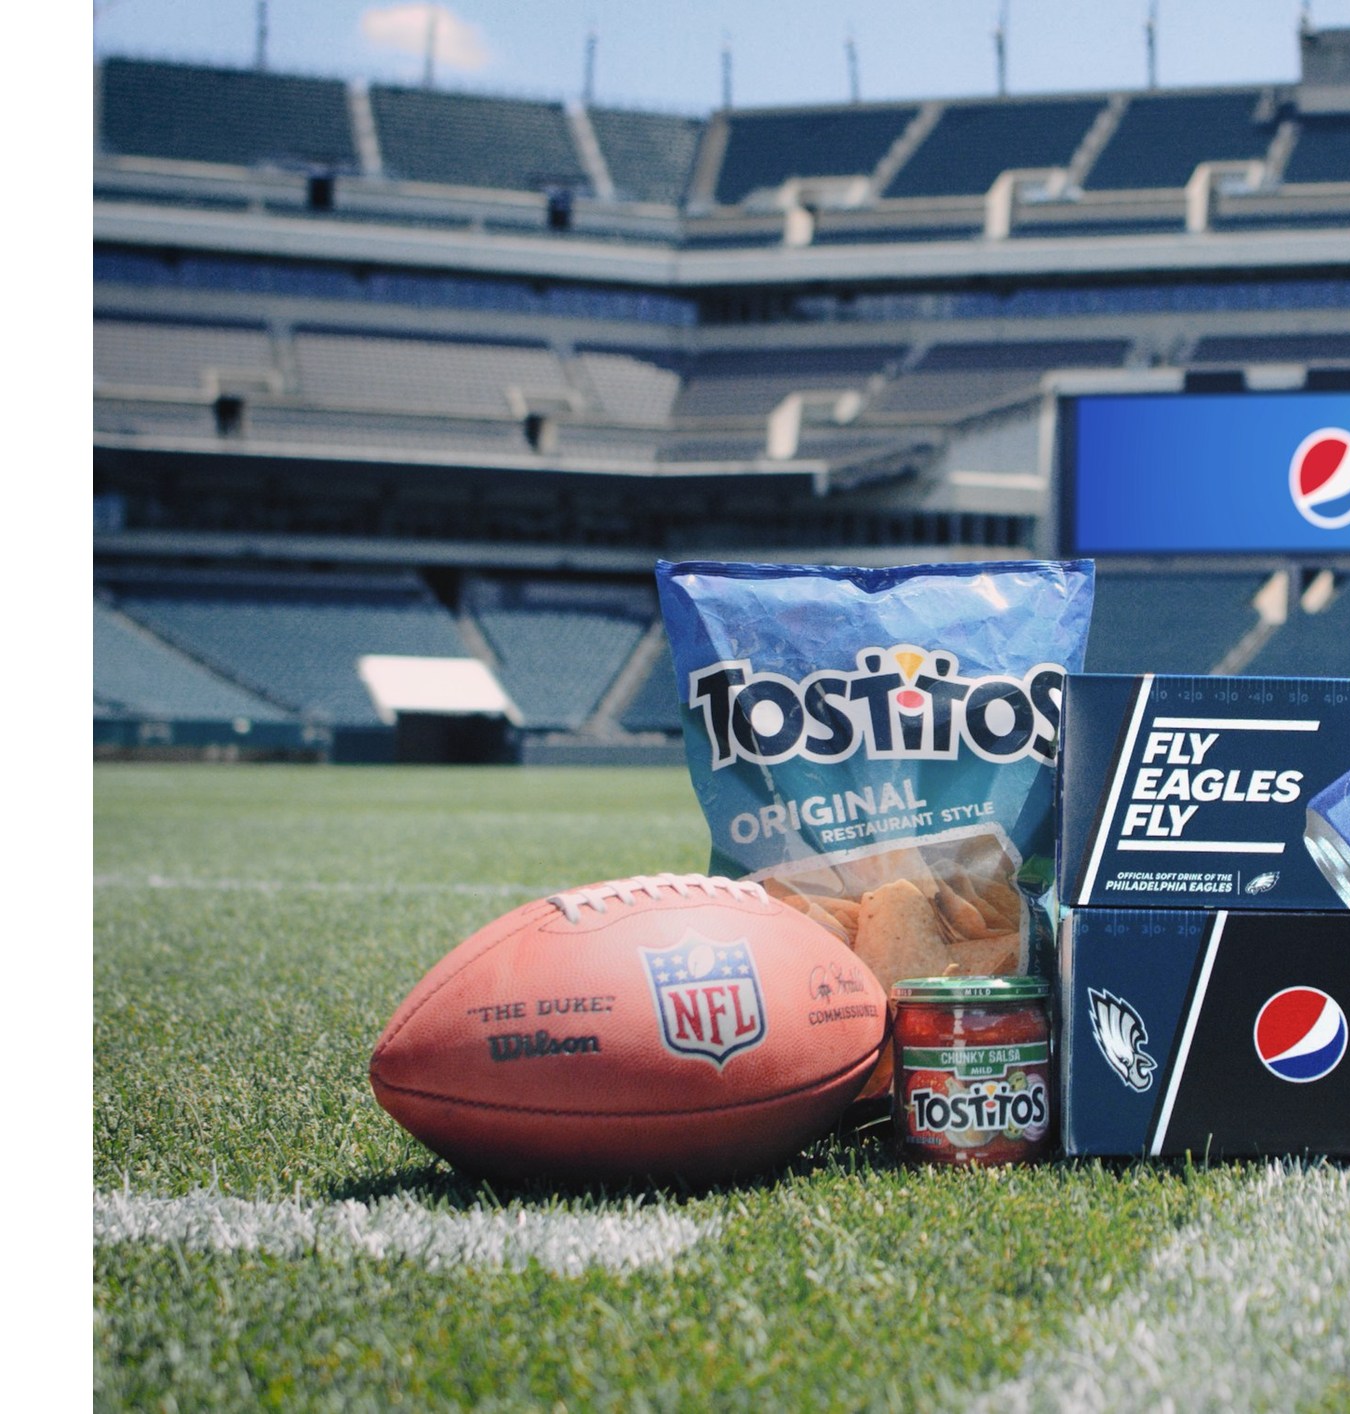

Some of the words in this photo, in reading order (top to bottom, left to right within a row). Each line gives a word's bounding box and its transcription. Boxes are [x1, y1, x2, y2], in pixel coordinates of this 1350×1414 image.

[1141, 732, 1219, 765] FLY
[1131, 768, 1304, 804] EAGLES
[730, 778, 926, 845] ORIGINAL
[821, 812, 934, 844] RESTAURANT
[941, 801, 995, 823] STYLE
[1120, 804, 1199, 837] FLY
[1105, 880, 1187, 892] PHILADELPHIA
[1189, 881, 1233, 893] EAGLES
[1117, 872, 1154, 880] OFFICIAL
[1155, 872, 1177, 881] SOFT
[1178, 873, 1203, 881] DRINK
[1204, 873, 1215, 881] OF
[1216, 873, 1233, 882] THE
[965, 988, 991, 996] MILD
[668, 984, 755, 1047] NFL
[487, 1030, 602, 1062] Wilson
[940, 1050, 985, 1065] CHUNKY
[988, 1049, 1021, 1063] SALSA
[970, 1066, 993, 1075] MILD
